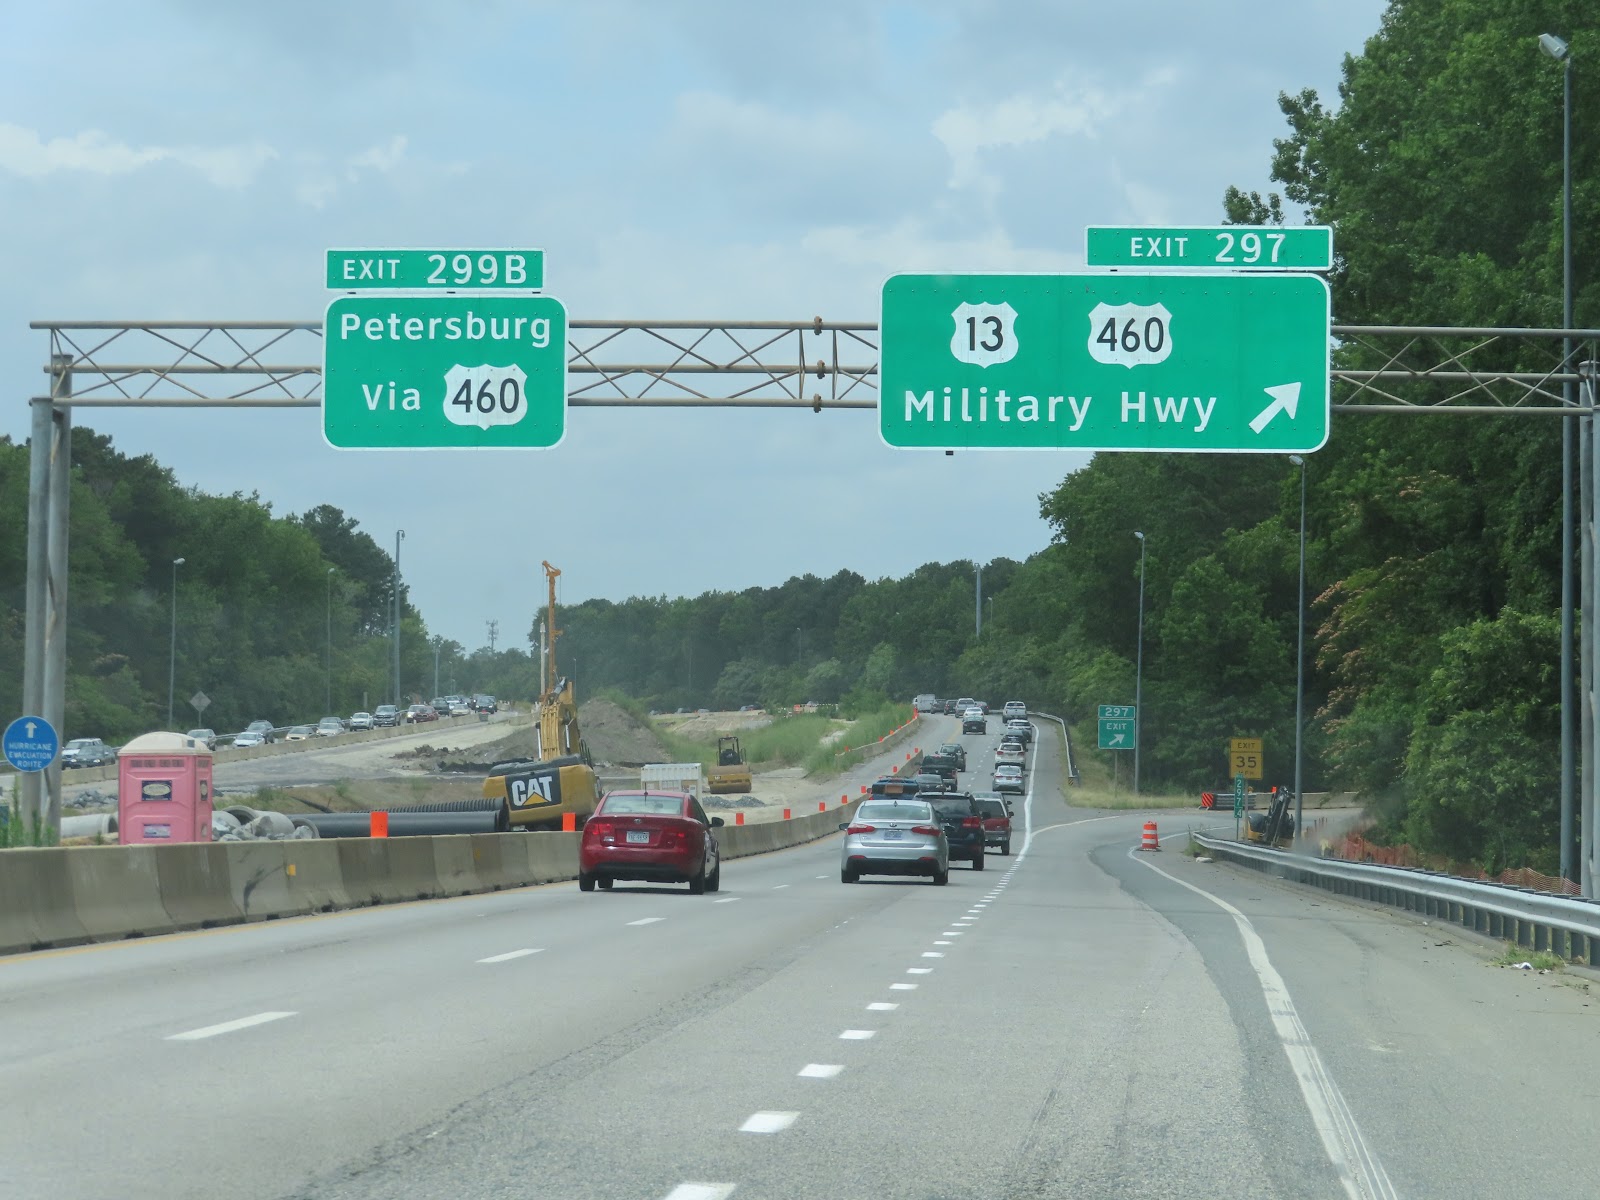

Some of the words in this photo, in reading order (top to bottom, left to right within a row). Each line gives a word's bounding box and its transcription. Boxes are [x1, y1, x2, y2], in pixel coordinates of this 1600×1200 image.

[1130, 237, 1189, 258] EXIT
[1214, 232, 1287, 263] 297
[343, 259, 400, 280] EXIT
[426, 254, 527, 284] 299B
[340, 311, 551, 349] Petersburg
[966, 316, 1004, 352] 13
[1096, 316, 1165, 353] 460
[361, 381, 421, 411] Via
[451, 377, 520, 414] 460
[904, 387, 1093, 432] Military
[1120, 391, 1218, 433] Hwy
[1104, 707, 1129, 717] 297
[1106, 722, 1127, 730] EXIT
[8, 751, 52, 760] EVACUATION
[9, 742, 52, 751] HURRICANE
[17, 760, 42, 768] ROUTE
[1235, 755, 1257, 769] 35
[511, 776, 553, 807] CAT
